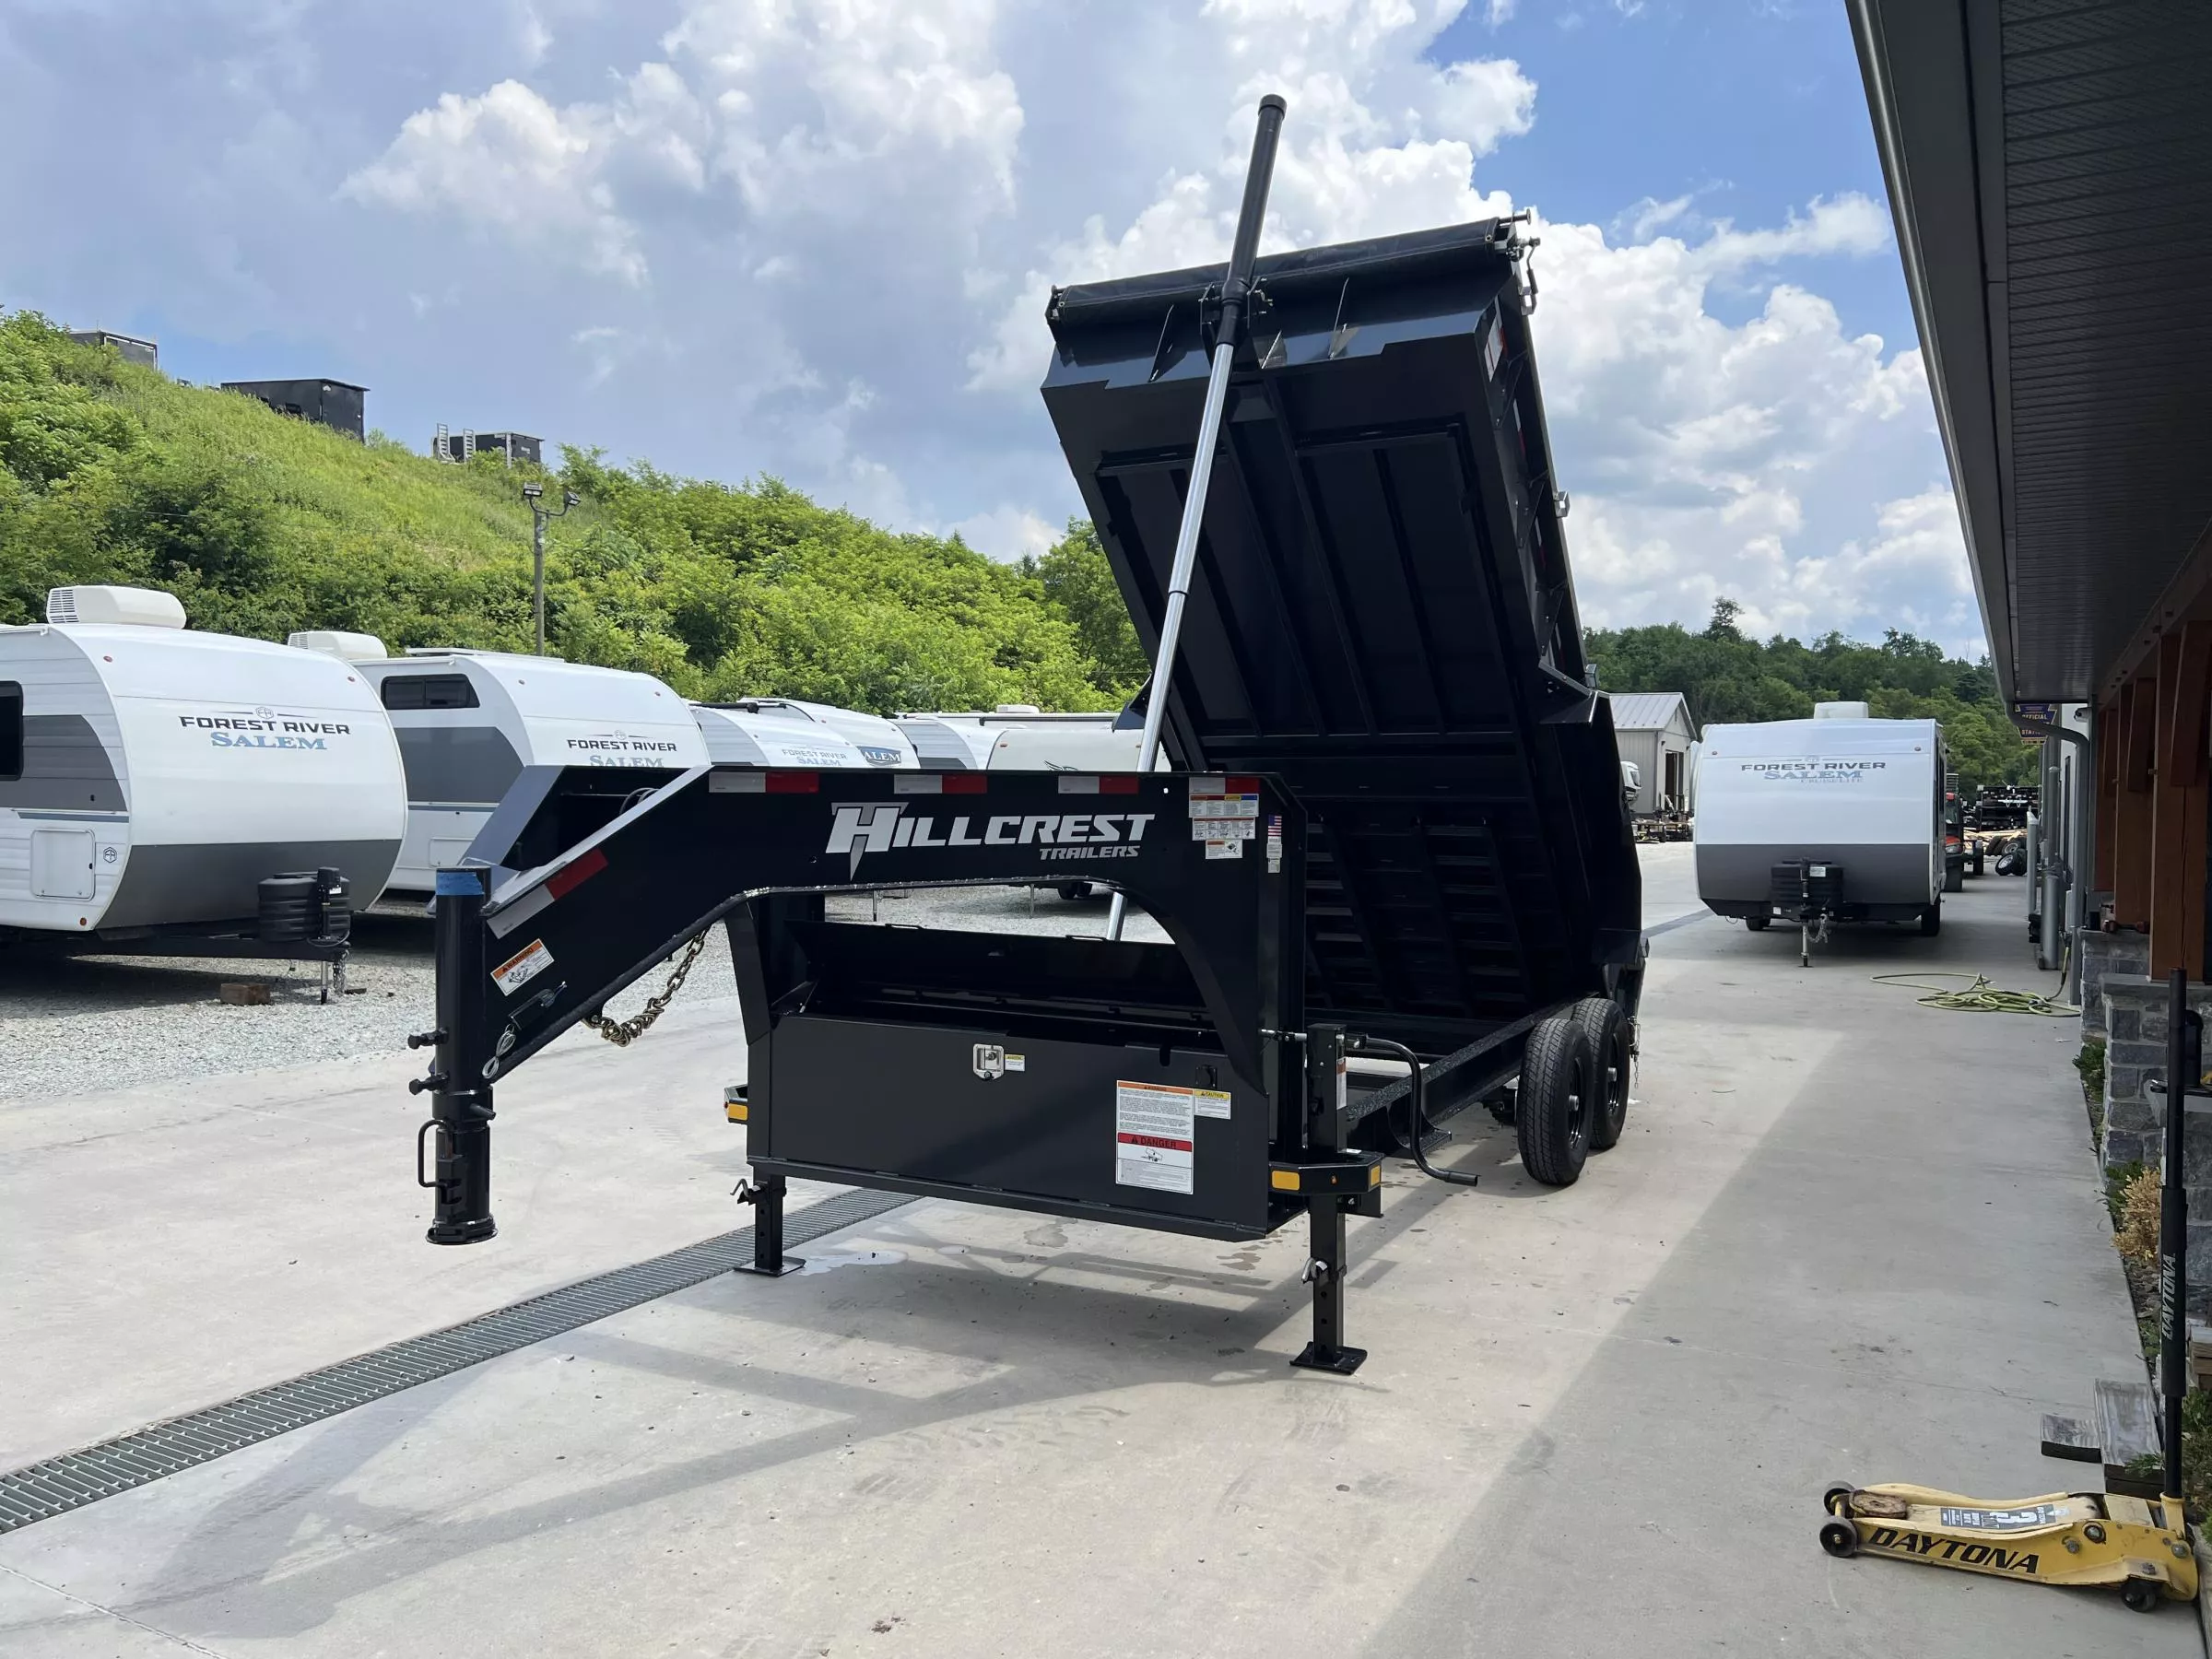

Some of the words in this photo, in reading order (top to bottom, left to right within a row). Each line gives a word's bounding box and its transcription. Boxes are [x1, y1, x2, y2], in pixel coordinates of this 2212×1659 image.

[178, 716, 277, 731] FOREST
[282, 722, 351, 735] RIVER
[210, 732, 328, 750] SALEM
[567, 739, 629, 750] FOREST
[631, 741, 677, 752] RIVER
[782, 748, 819, 758] FOREST
[819, 752, 847, 760] RIVER
[864, 751, 901, 762] ALEM
[590, 755, 664, 767] SALEM
[796, 756, 841, 766] SALEM
[1740, 763, 1819, 771] FOREST
[1824, 761, 1887, 770] RIVER
[1764, 771, 1863, 780] SALEM
[826, 804, 1155, 857] HILLCREST
[1039, 845, 1141, 861] TRAILERS
[1140, 1137, 1177, 1148] DANGER
[2161, 1253, 2176, 1341] DAYTONA
[1989, 1512, 2038, 1524] 3
[1868, 1527, 2040, 1574] DAYTONA
